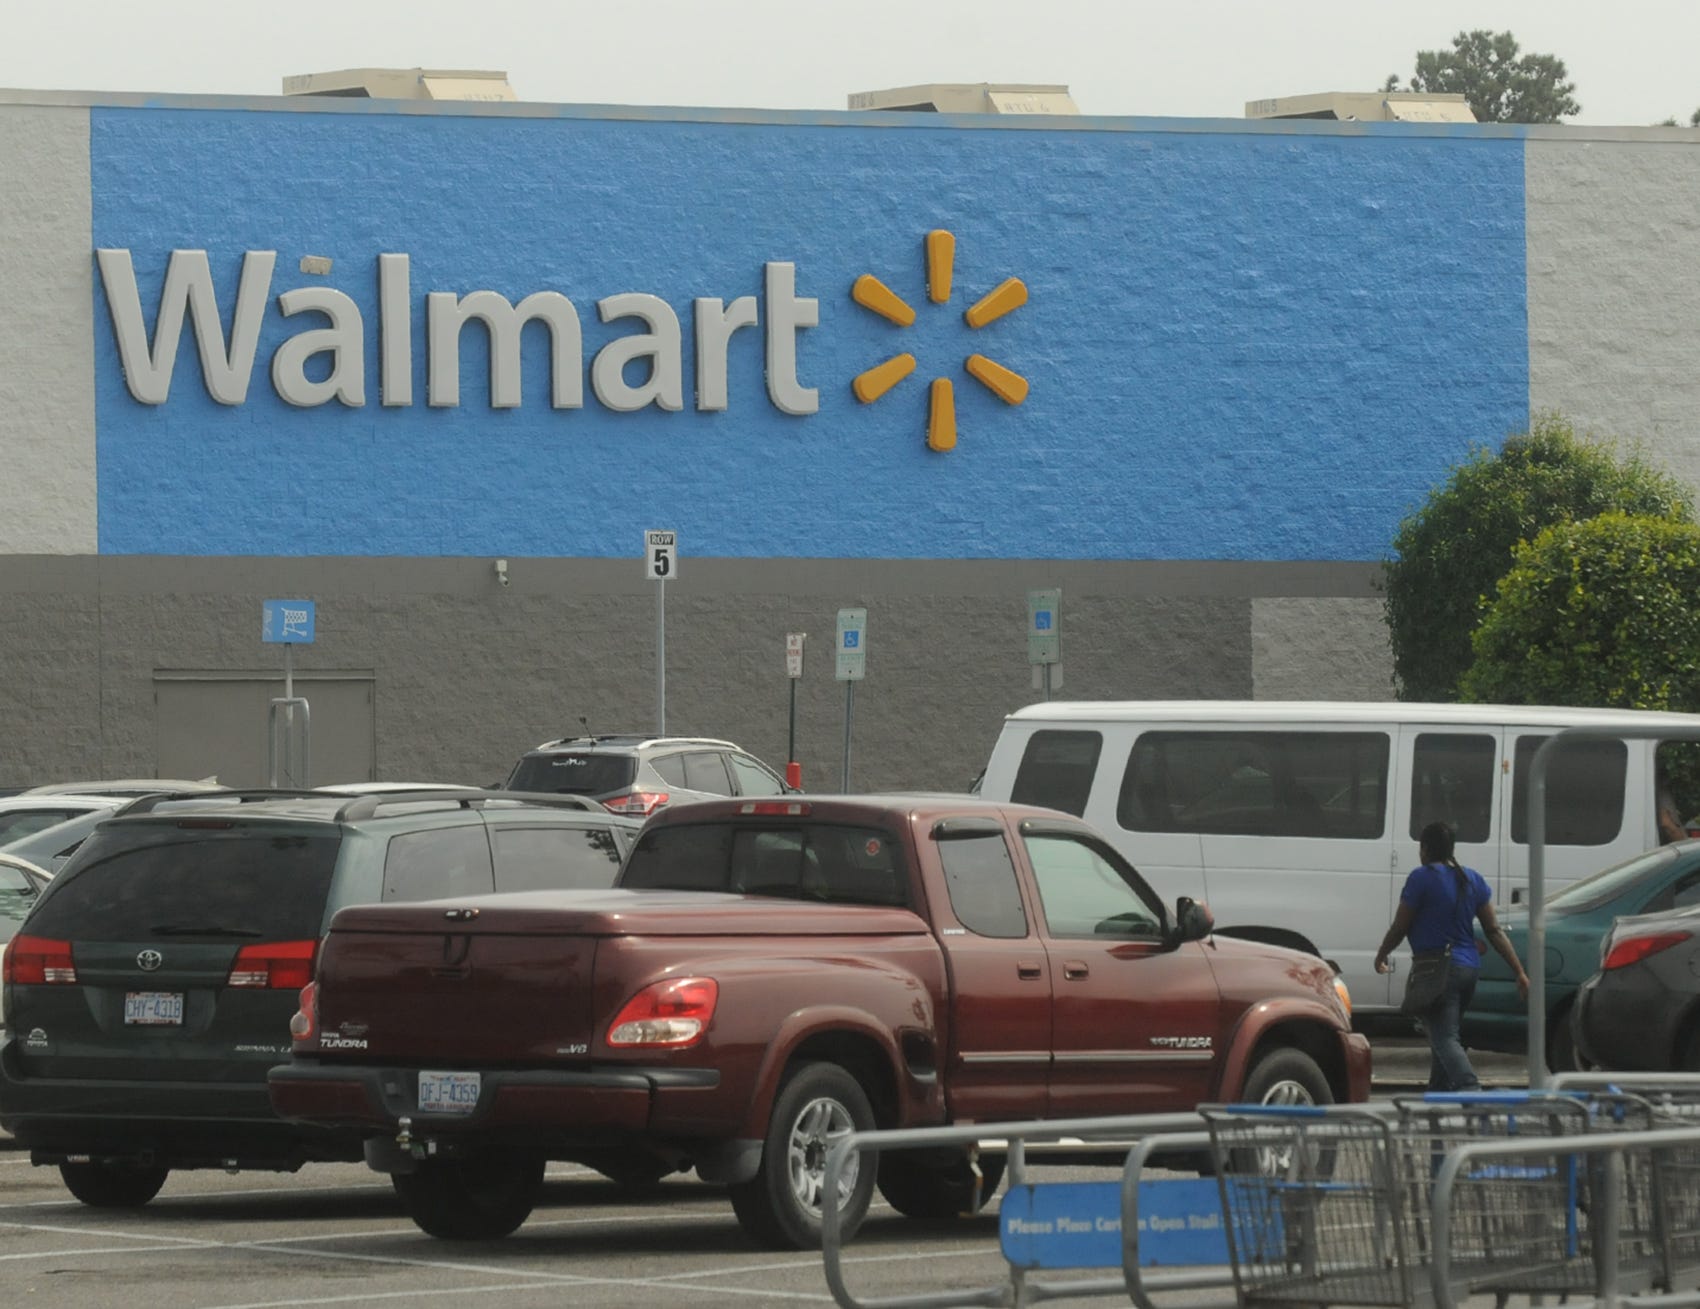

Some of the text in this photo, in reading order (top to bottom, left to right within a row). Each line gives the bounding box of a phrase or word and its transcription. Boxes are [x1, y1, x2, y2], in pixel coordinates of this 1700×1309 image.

[97, 247, 819, 415] Walmart
[651, 535, 673, 545] ROW
[654, 548, 670, 576] 5
[320, 1039, 368, 1049] TUNDRA
[1168, 1037, 1212, 1048] TUNDRA
[1095, 1216, 1122, 1232] Cart
[1150, 1215, 1185, 1232] Open
